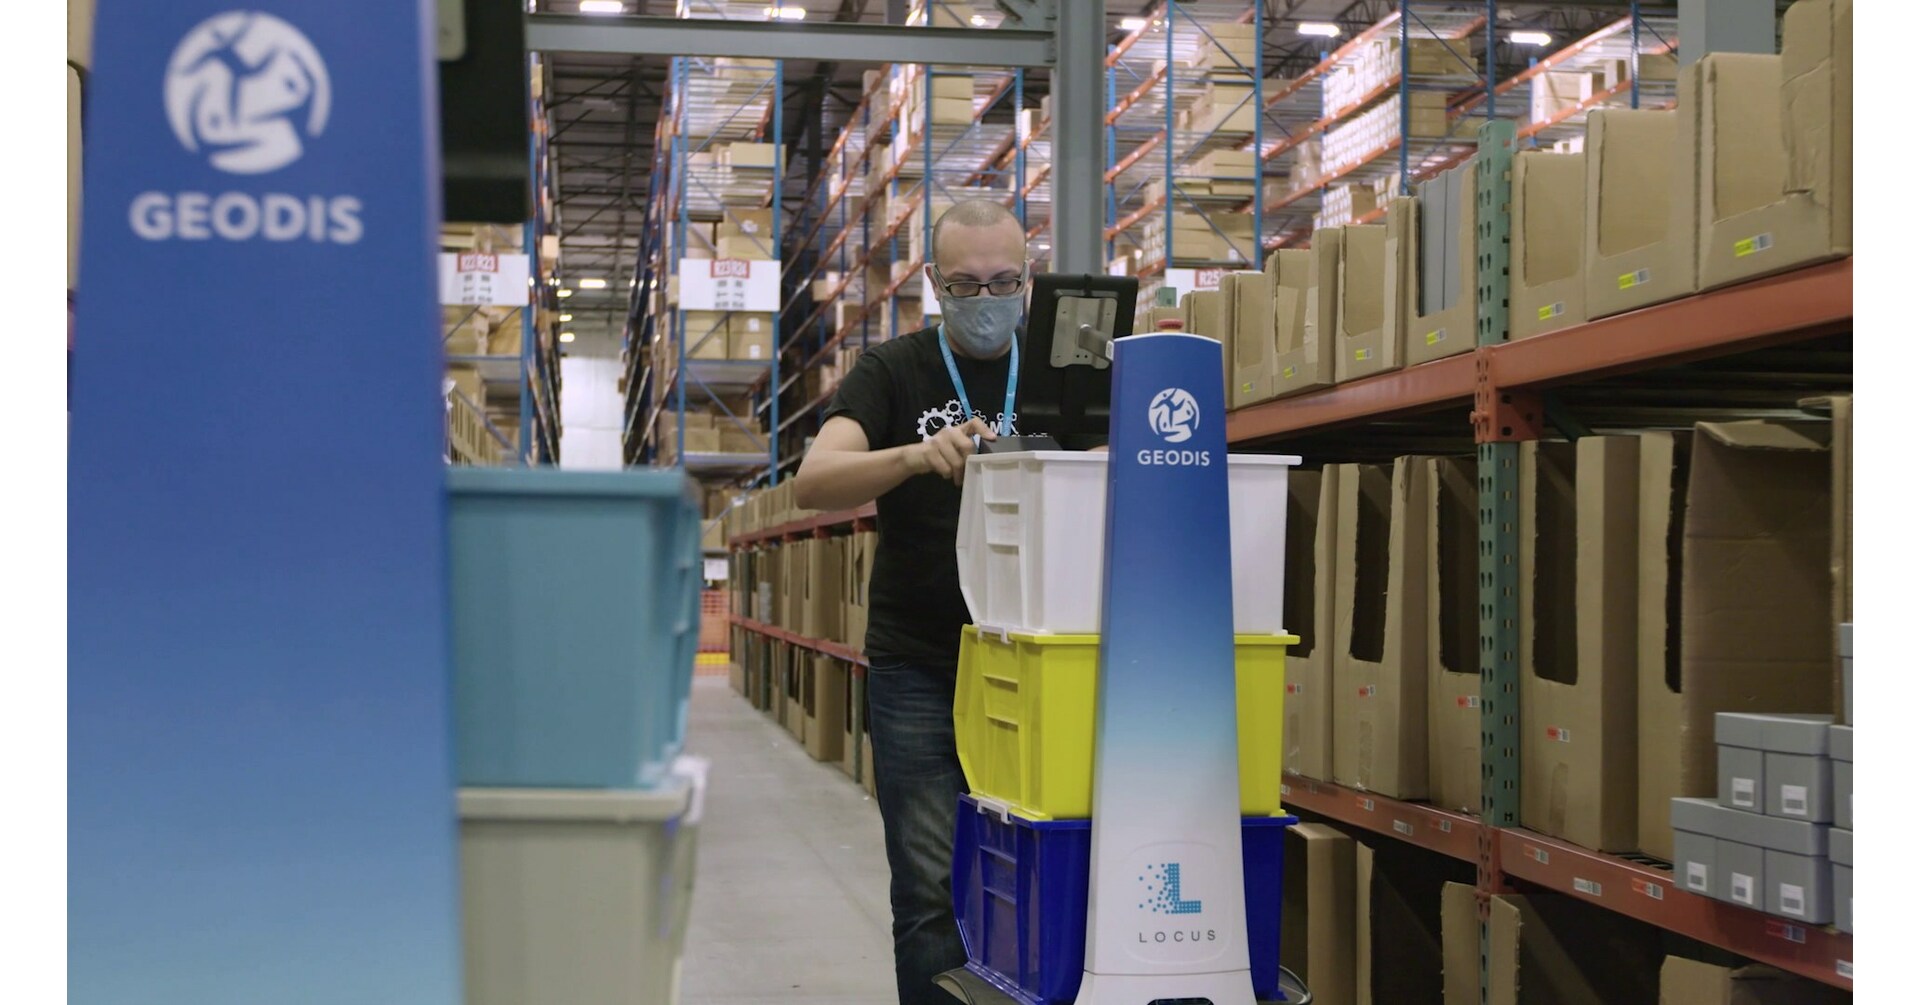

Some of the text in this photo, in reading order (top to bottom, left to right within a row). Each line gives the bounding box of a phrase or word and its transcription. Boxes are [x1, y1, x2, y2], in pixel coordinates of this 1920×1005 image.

[130, 191, 364, 243] GEODIS
[1137, 449, 1210, 466] GEODIS
[1139, 929, 1216, 943] LOCUS
